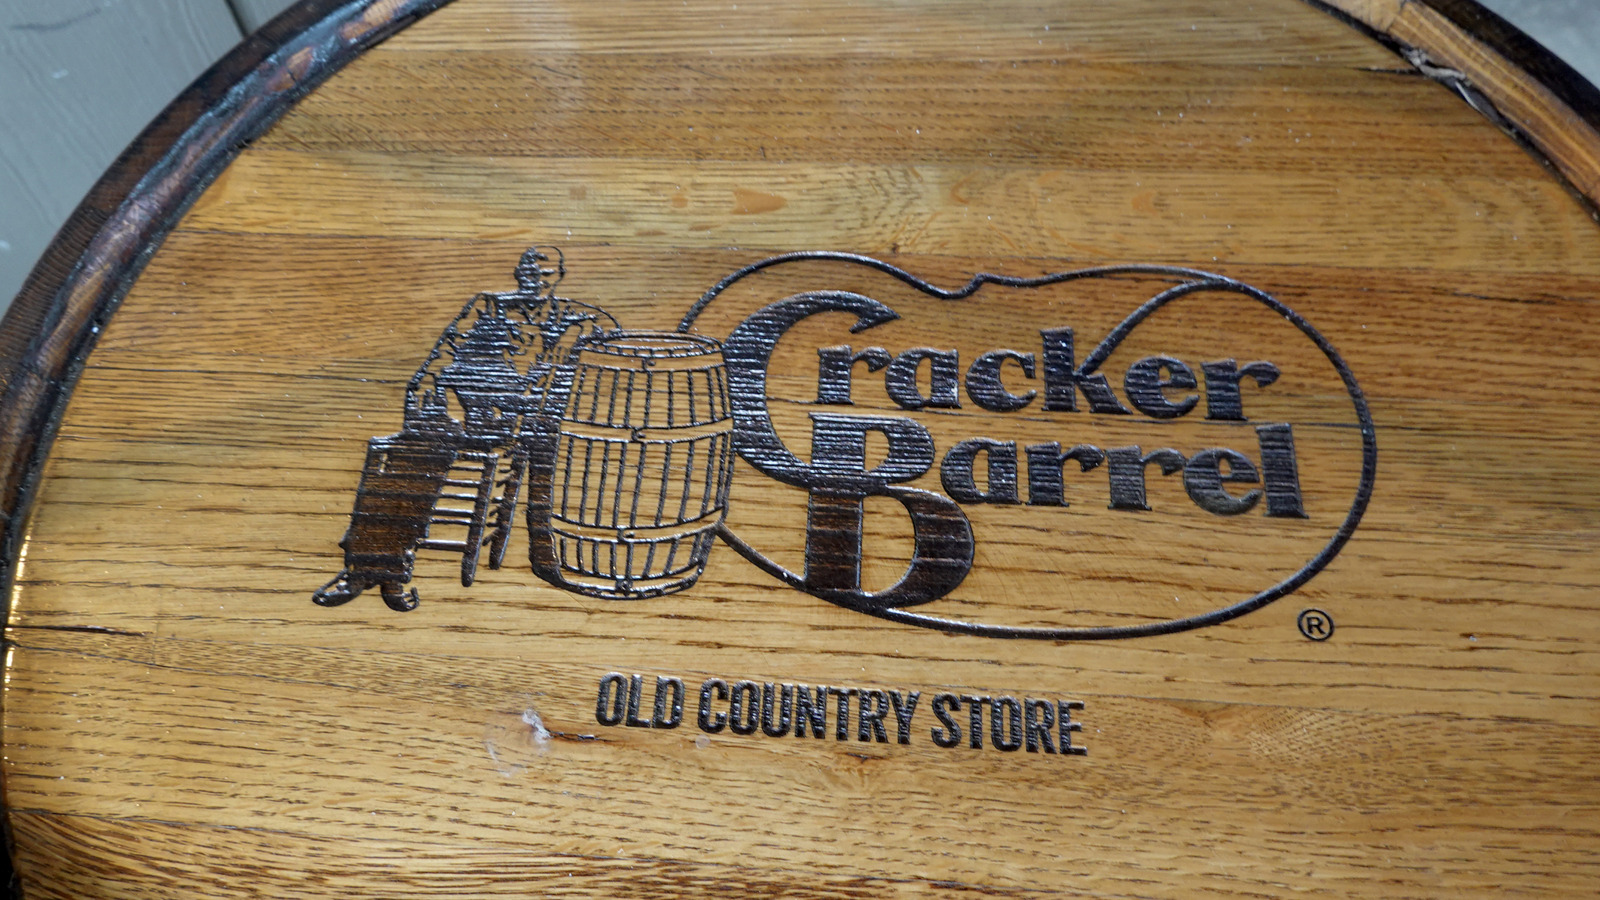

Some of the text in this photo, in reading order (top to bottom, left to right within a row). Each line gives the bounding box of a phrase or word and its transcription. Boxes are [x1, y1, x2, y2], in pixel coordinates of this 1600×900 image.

[722, 290, 1280, 491] Cracker
[802, 411, 1309, 608] Barrel
[595, 671, 1088, 757] OLD COUNTRY STORE
